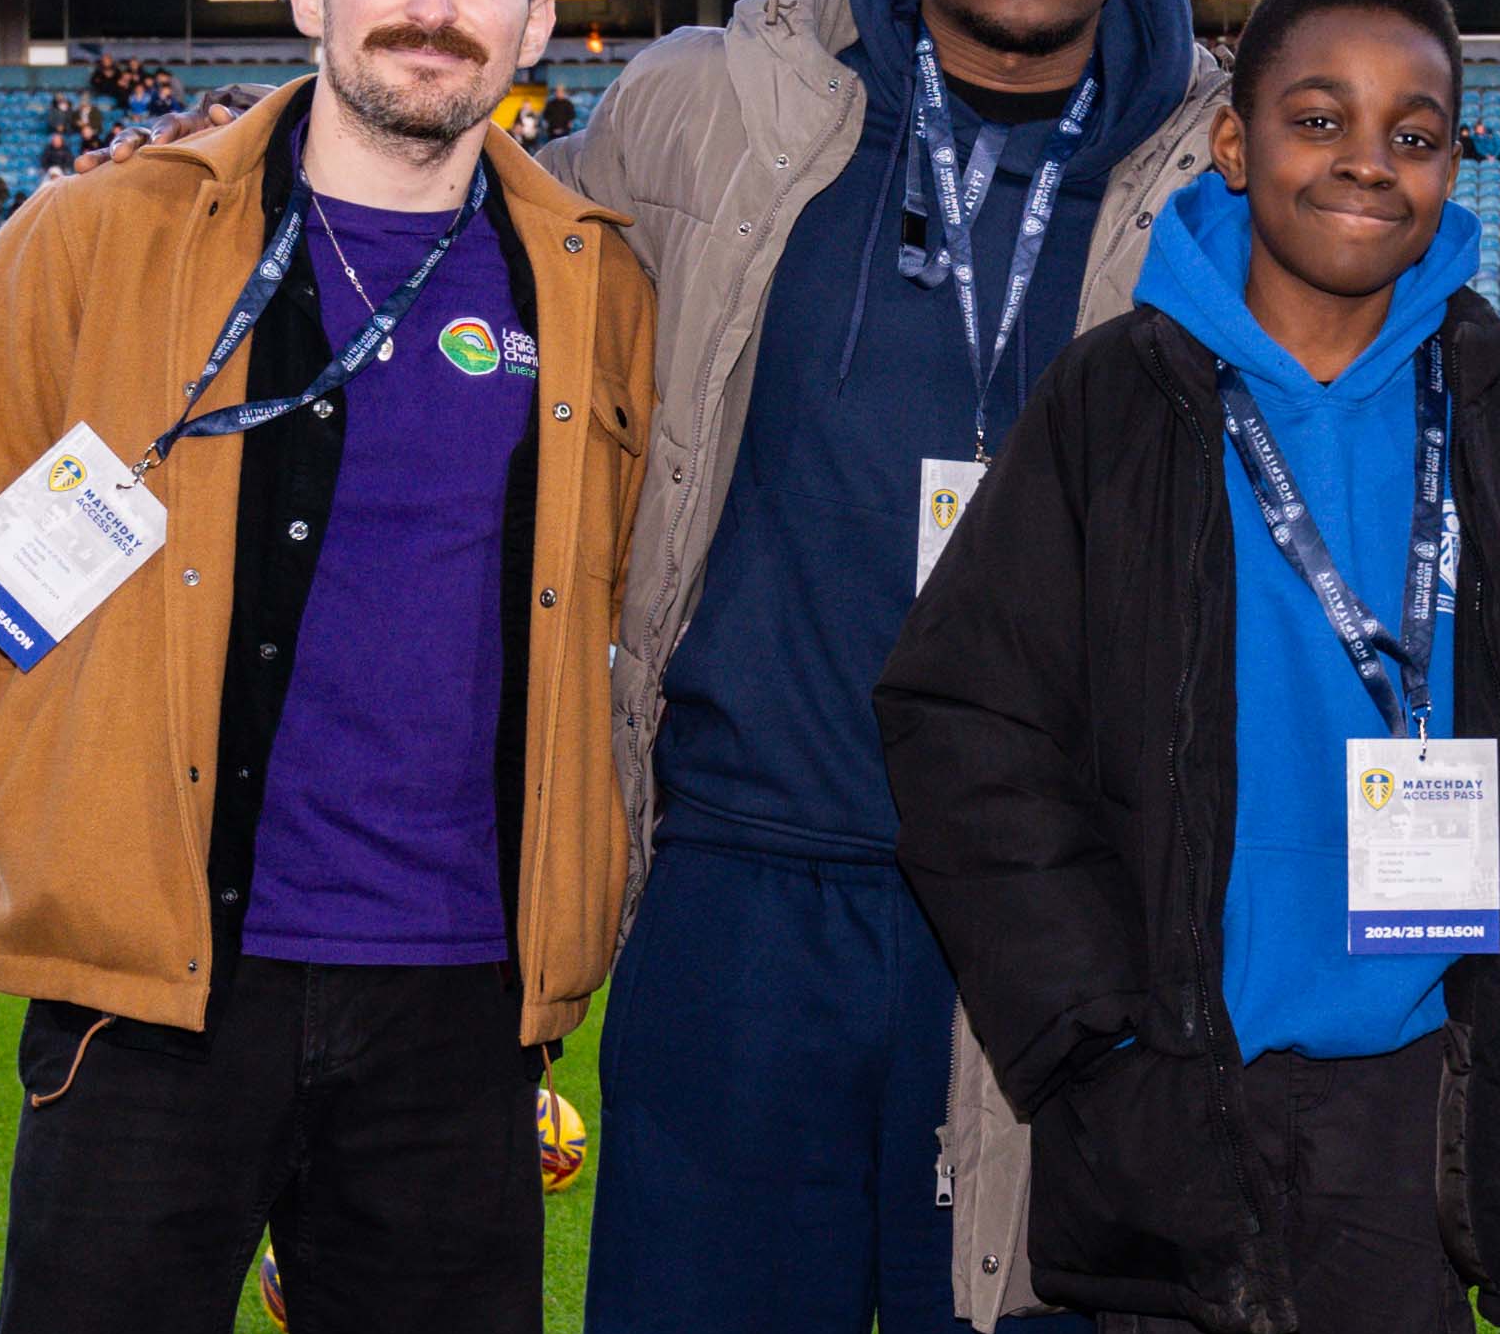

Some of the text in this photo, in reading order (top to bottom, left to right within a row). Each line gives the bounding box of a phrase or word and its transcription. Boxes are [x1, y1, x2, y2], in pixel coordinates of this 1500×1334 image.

[918, 55, 935, 107] HOSPITALITY
[926, 54, 942, 108] LEEDS UNITED
[940, 168, 954, 225] HOSPITALITY
[946, 168, 961, 225] LEEDS UNITED
[1031, 161, 1053, 214] LEEDS UNITED
[1038, 163, 1060, 216] HOSPITALITY
[274, 213, 299, 264] LEEDS UNITED
[279, 218, 302, 267] HOSPITALITY
[342, 327, 376, 367] HOSPITALITY
[347, 330, 382, 371] LEEDS UNITED
[504, 350, 539, 367] Chari
[1248, 418, 1295, 501] HOSPITALITY
[74, 496, 134, 557] ACCESS PASS
[82, 487, 143, 550] MATCHDAY
[1321, 572, 1370, 660] HOSPITALITY
[1414, 562, 1424, 619] HOSPITALITY
[1421, 563, 1432, 620] LEEDS UNITED
[1403, 780, 1483, 789] MATCHDAY
[1404, 791, 1483, 800] ACCESS PASS
[1365, 926, 1485, 938] 2024/25 SEASON
